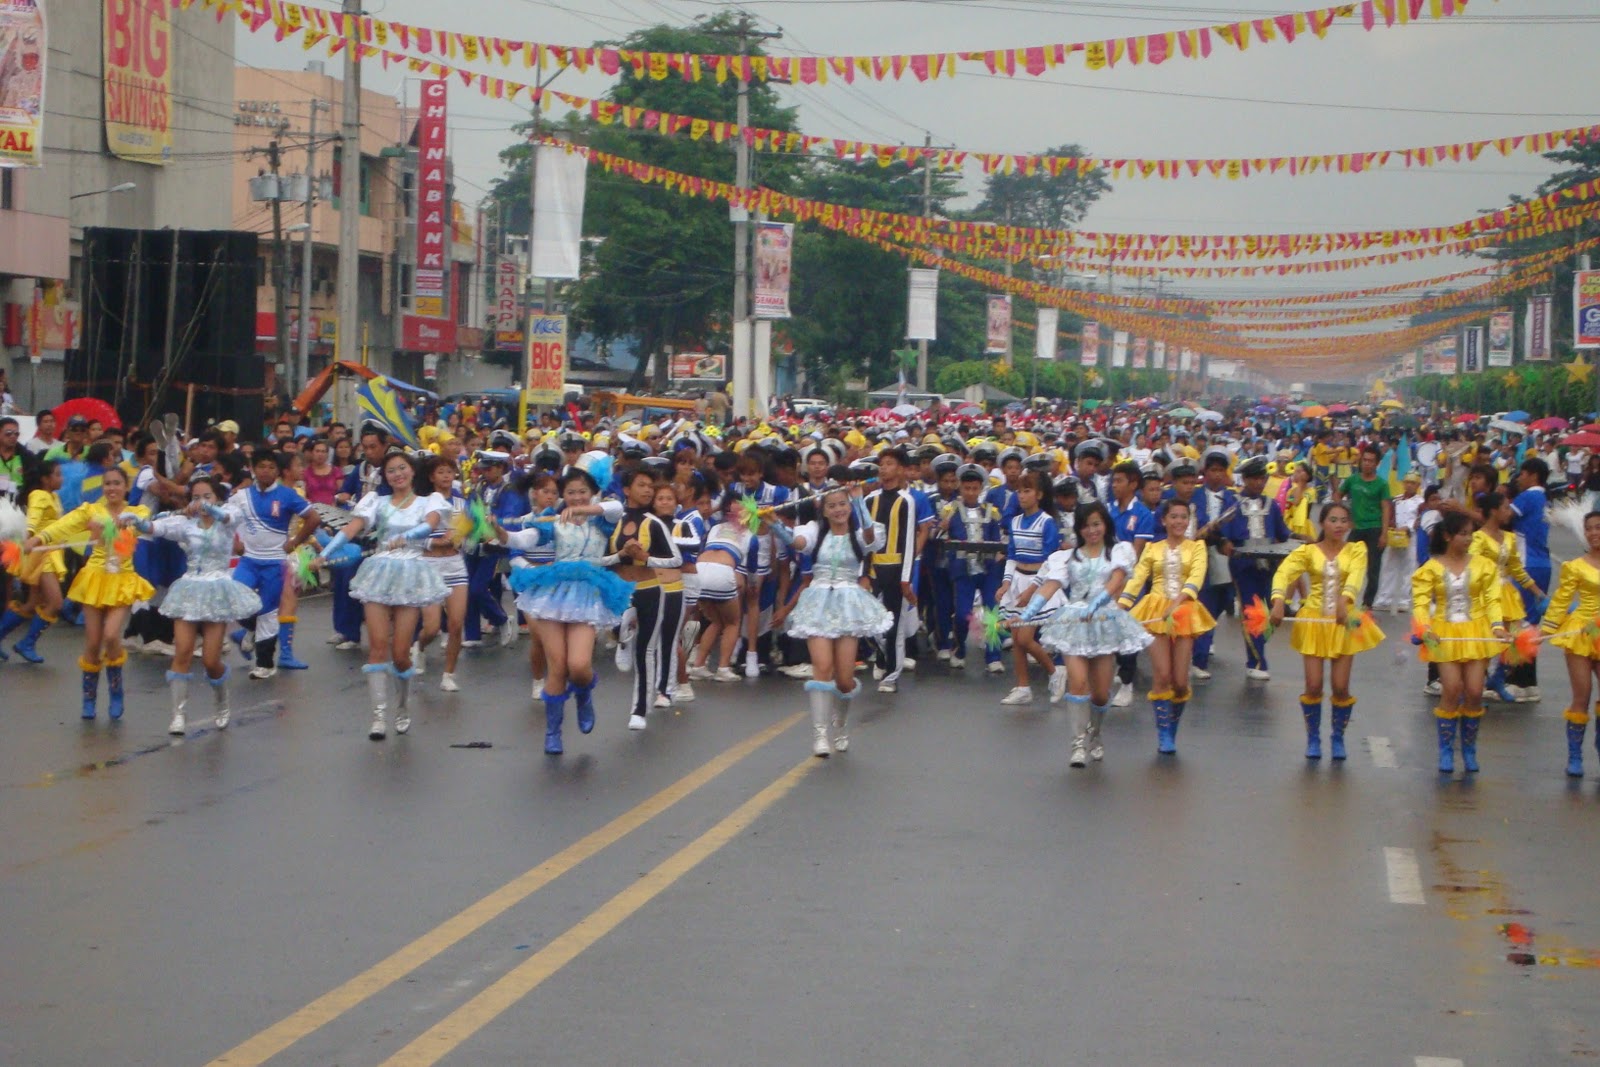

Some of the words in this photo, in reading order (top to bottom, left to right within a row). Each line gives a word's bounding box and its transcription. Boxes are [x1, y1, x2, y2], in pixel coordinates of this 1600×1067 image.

[106, 0, 168, 78] BIG
[107, 69, 167, 133] SAVINGS
[424, 84, 444, 265] CHINABANK
[498, 262, 515, 323] SHARP
[531, 341, 563, 371] BIG
[532, 317, 563, 335] KCC
